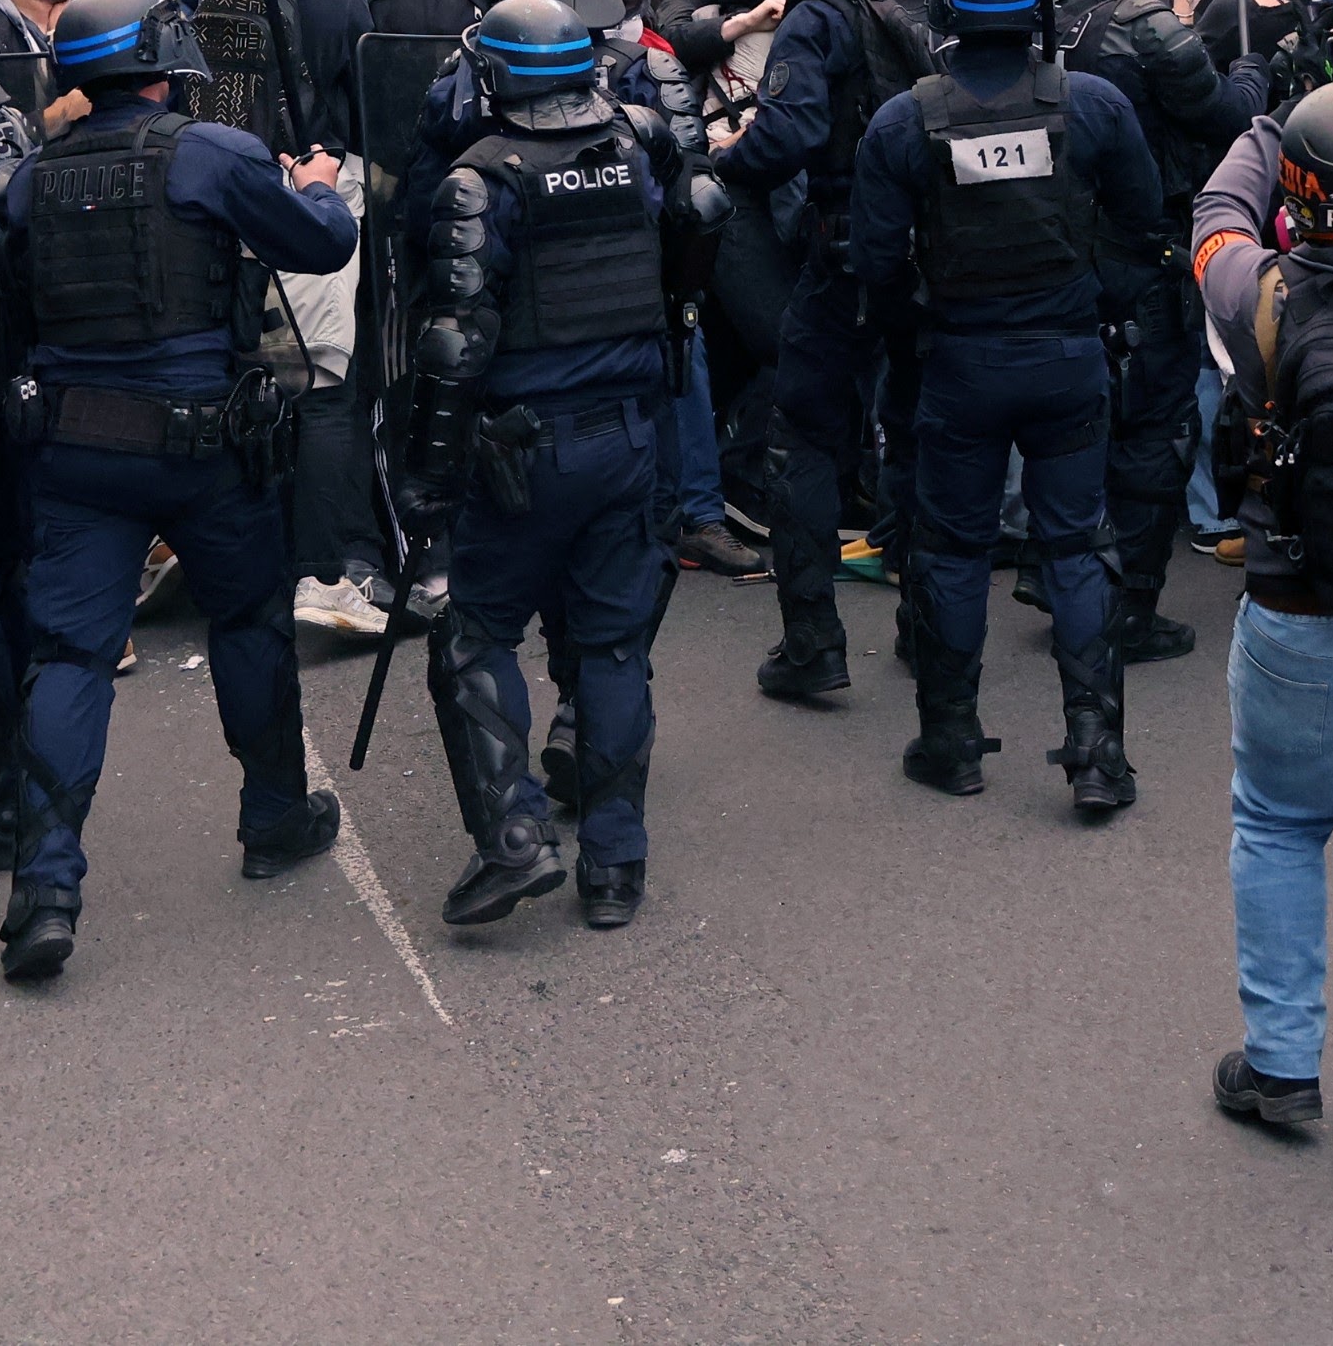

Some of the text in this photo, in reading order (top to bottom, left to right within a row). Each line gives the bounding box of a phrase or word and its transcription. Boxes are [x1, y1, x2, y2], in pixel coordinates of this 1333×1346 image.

[977, 143, 1026, 169] 121
[39, 161, 145, 205] POLICE
[545, 164, 632, 194] POLICE
